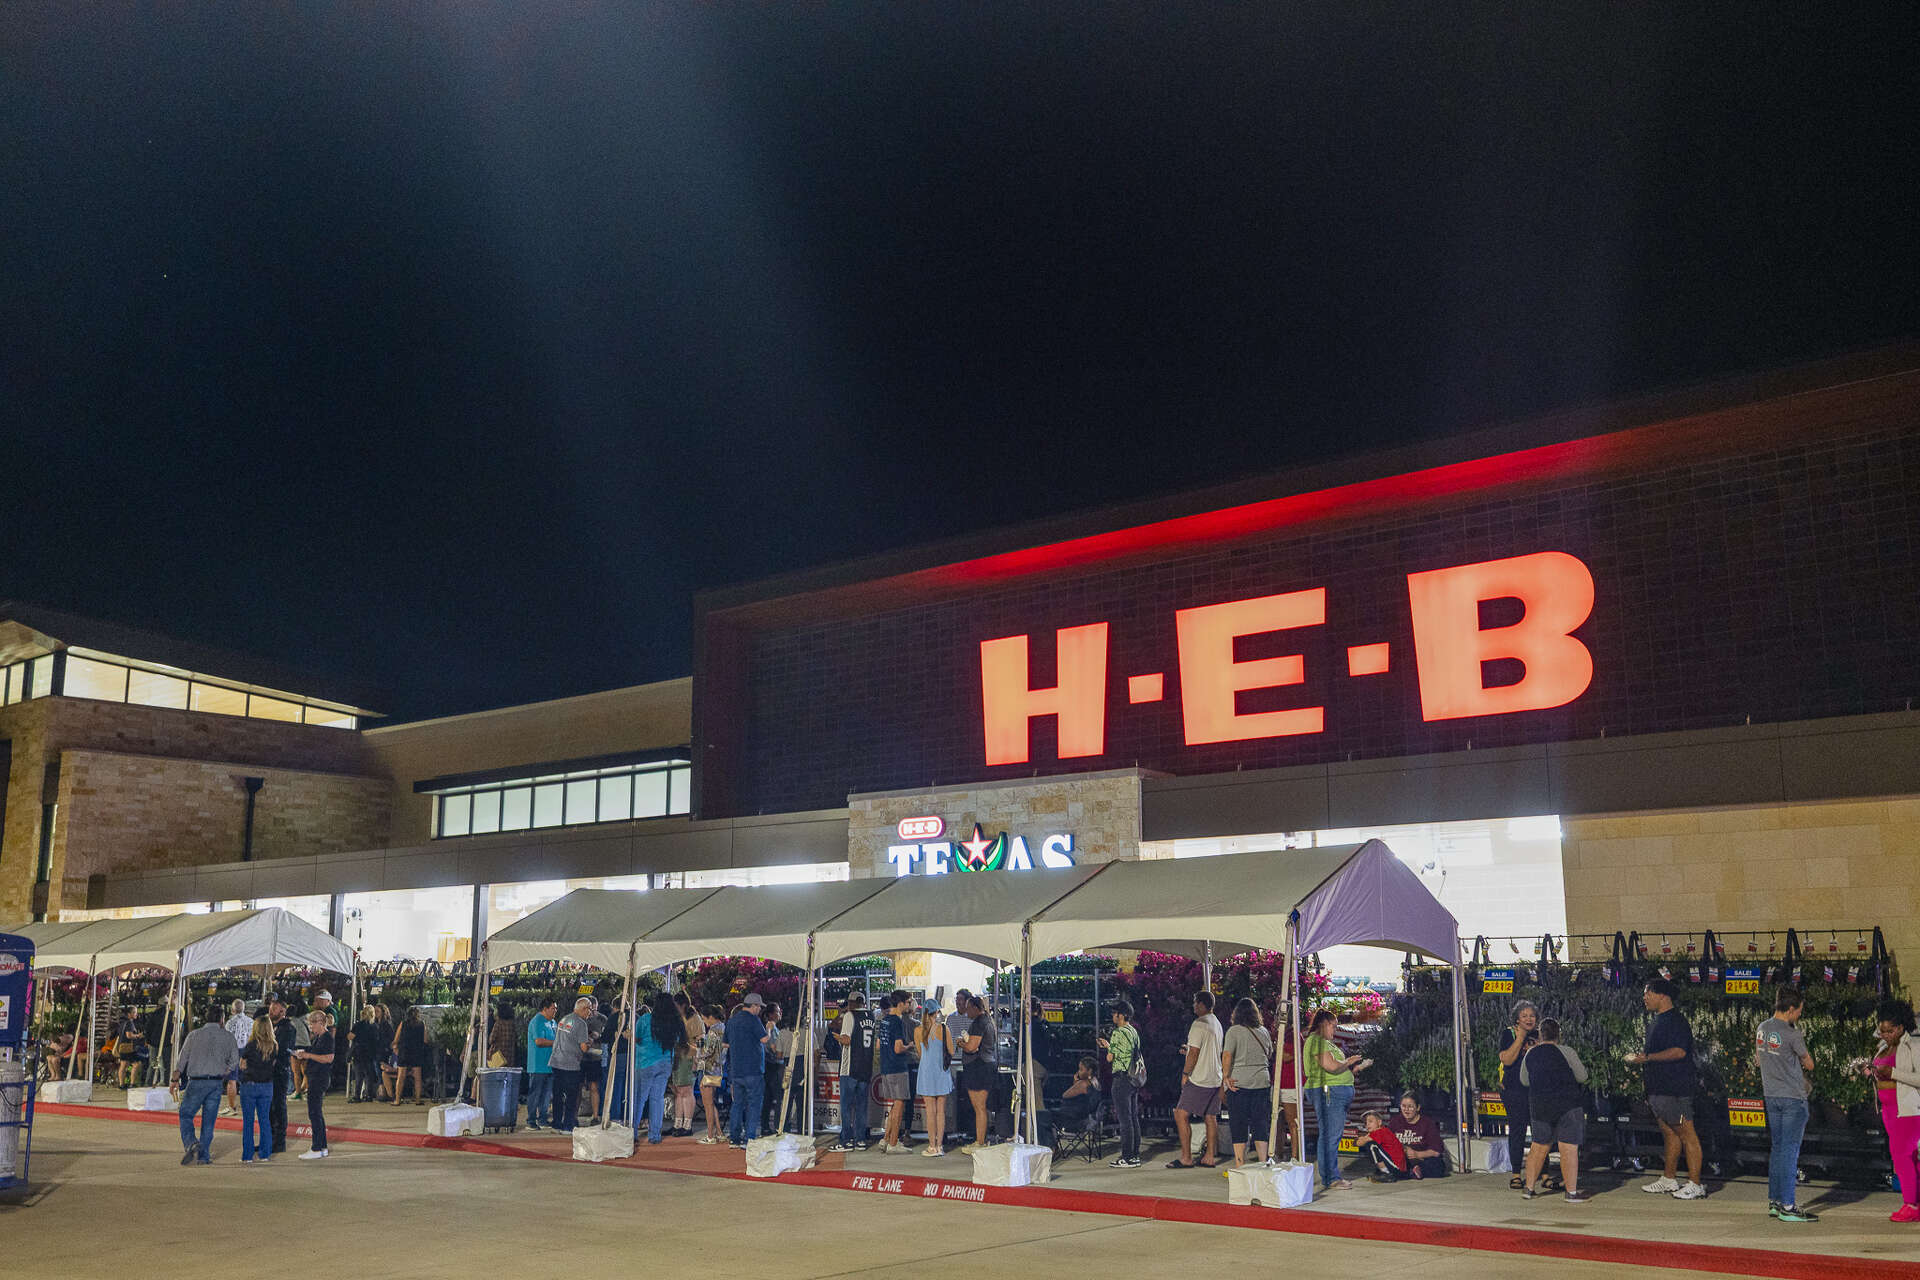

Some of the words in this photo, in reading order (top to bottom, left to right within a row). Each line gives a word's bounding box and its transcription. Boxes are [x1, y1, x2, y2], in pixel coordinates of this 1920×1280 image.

[863, 1030, 872, 1048] 5
[852, 1176, 875, 1190] FIRE
[878, 1179, 904, 1193] LANE
[923, 1182, 939, 1196] NO
[942, 1184, 985, 1202] PARKING
